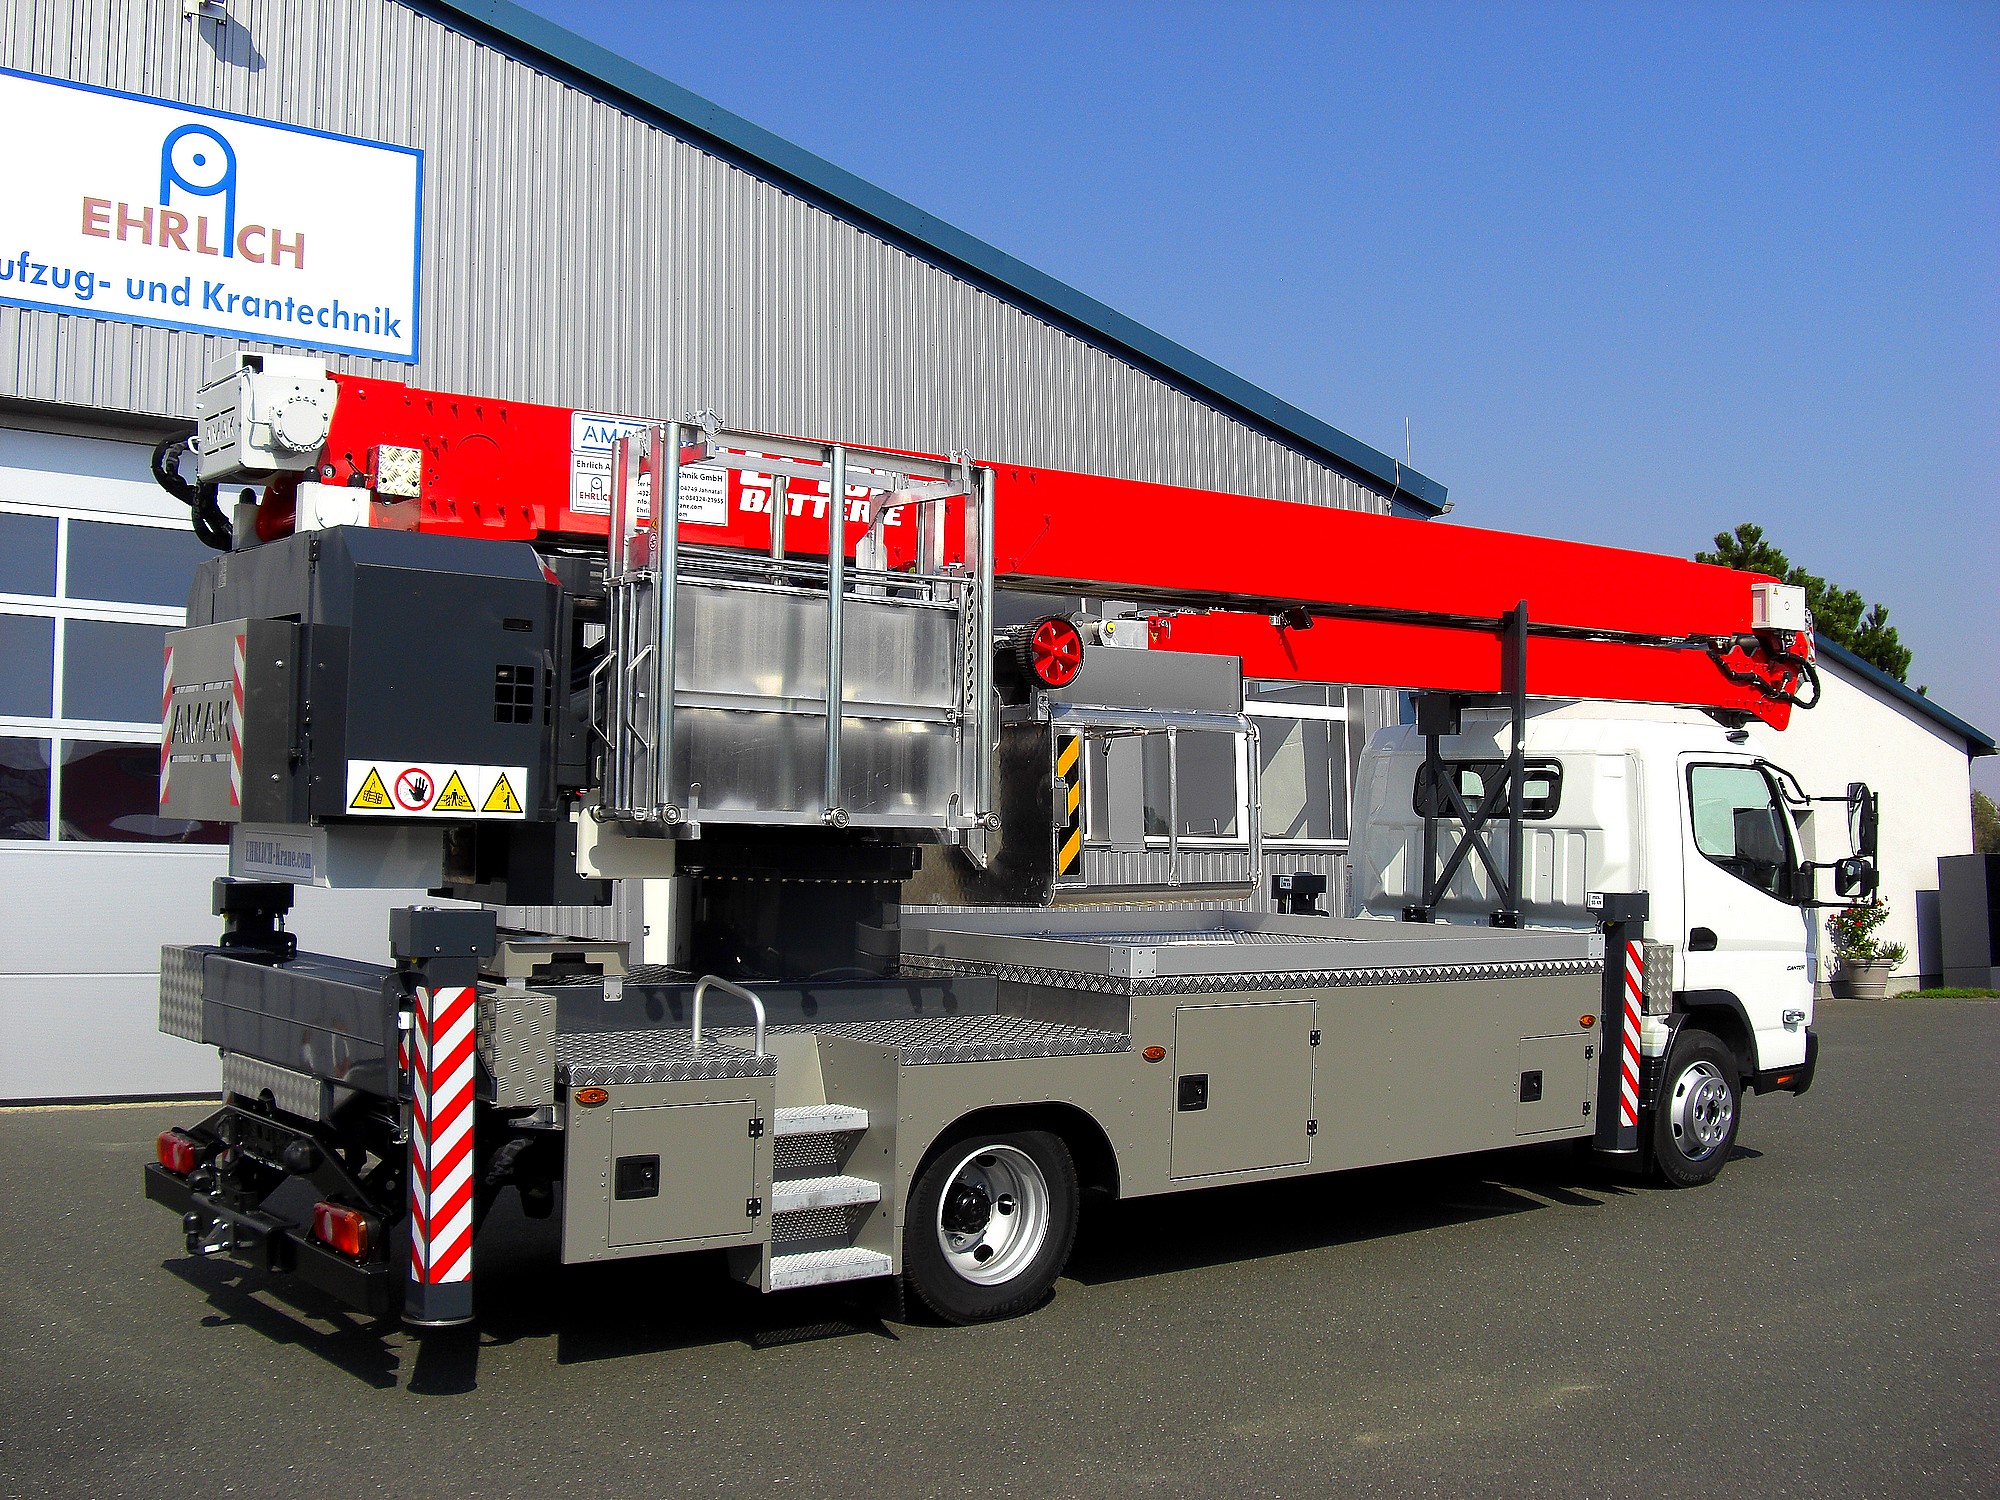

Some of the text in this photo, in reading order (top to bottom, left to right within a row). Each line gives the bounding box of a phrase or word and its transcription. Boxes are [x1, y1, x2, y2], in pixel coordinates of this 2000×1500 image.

[82, 196, 305, 270] EHRLICH
[126, 277, 191, 307] und
[203, 281, 402, 339] Krantechnik
[205, 416, 235, 446] AMAK
[583, 425, 632, 443] AM
[577, 460, 603, 470] Ehrlich
[700, 473, 723, 482] GmbH
[580, 491, 611, 502] EHRLIC
[171, 699, 232, 745] AMAK
